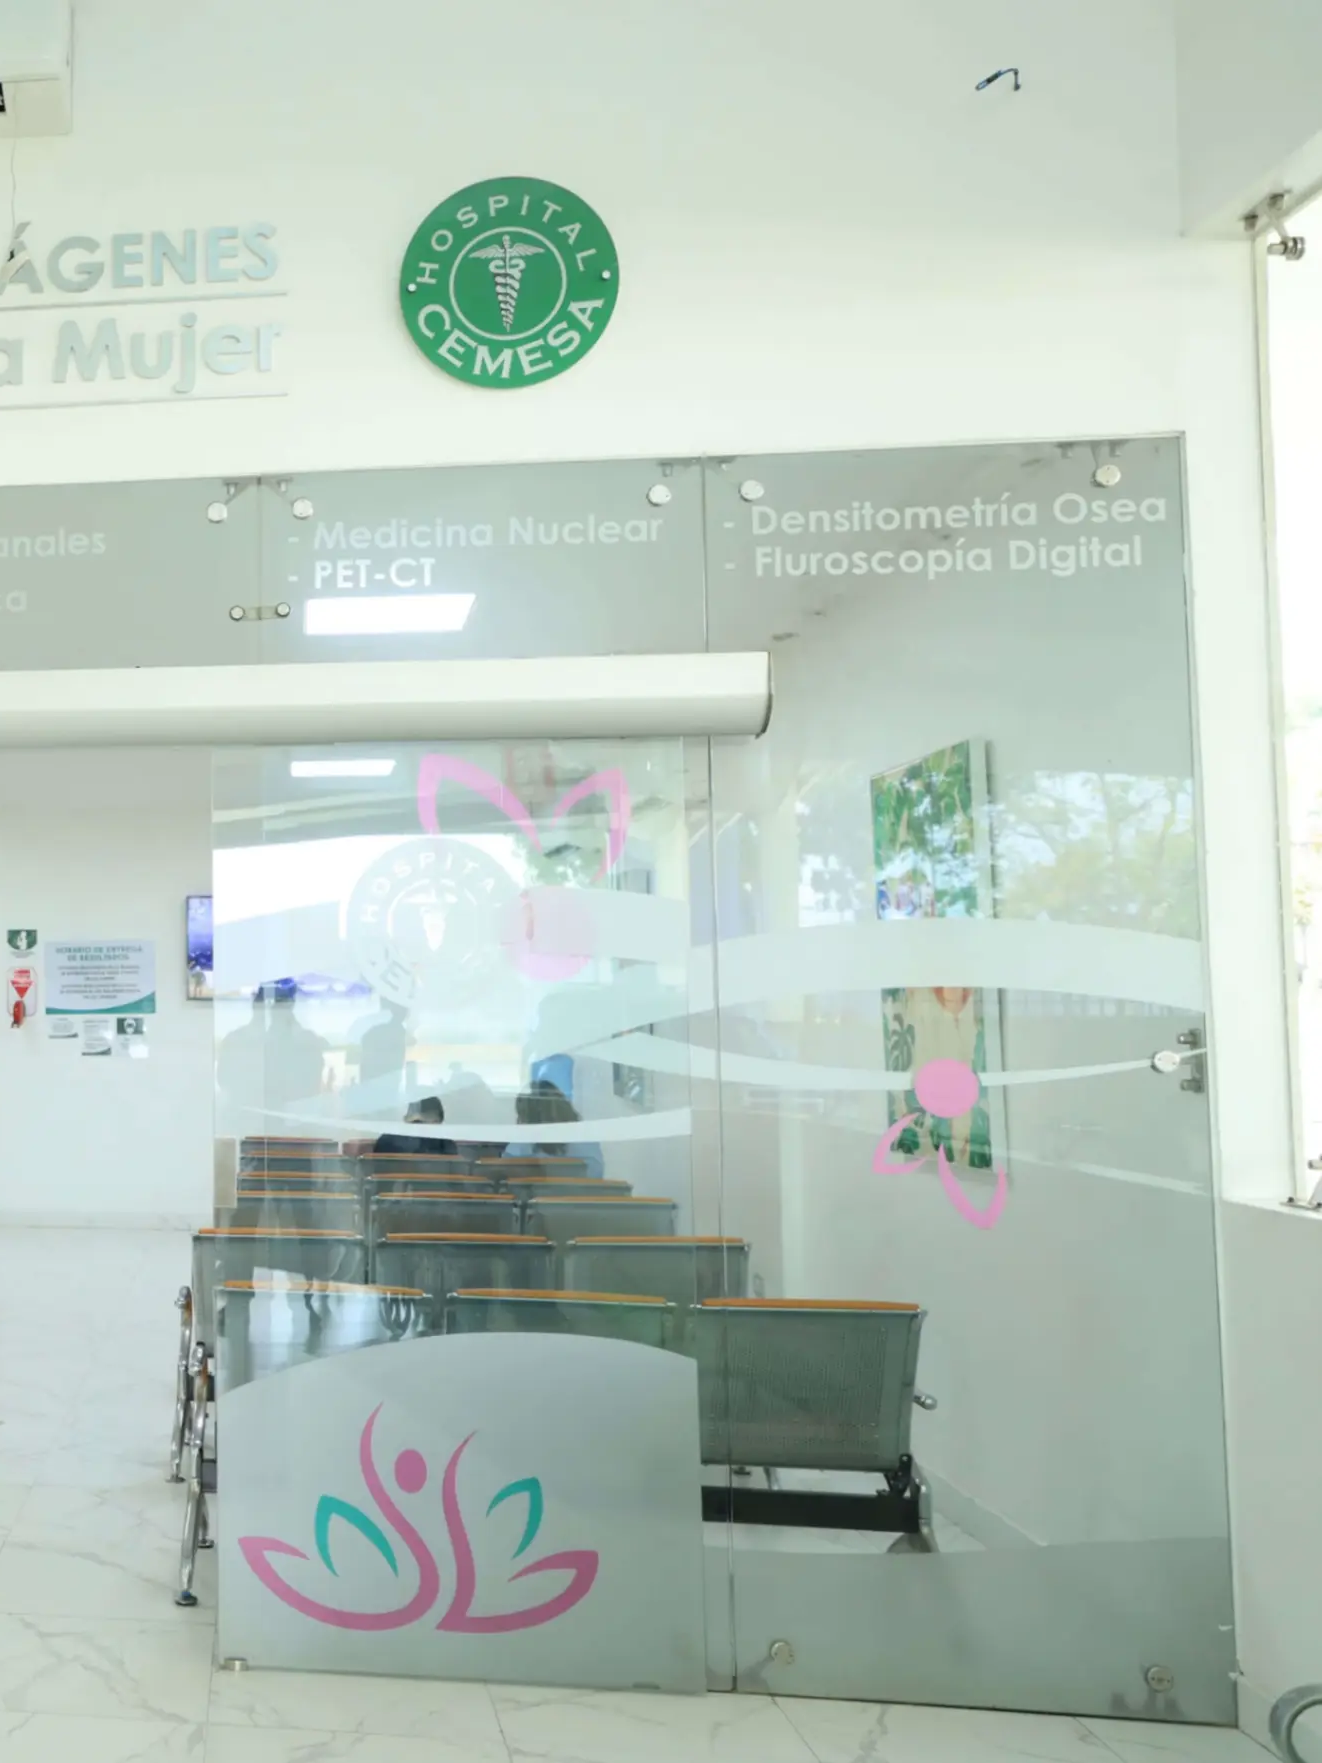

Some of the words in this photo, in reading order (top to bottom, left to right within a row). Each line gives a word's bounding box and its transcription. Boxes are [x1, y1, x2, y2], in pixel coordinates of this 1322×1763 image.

[416, 194, 597, 284] HOSPITAL
[51, 312, 284, 394] Mujer
[417, 298, 605, 379] CEMESA
[314, 521, 494, 550] Medicina
[509, 514, 664, 545] Nuclear
[751, 492, 1037, 535] Densitometría
[1053, 492, 1167, 525] Osea
[314, 557, 436, 589] PET-CT
[755, 537, 993, 580] Fluroscopía
[1009, 535, 1143, 577] Digital
